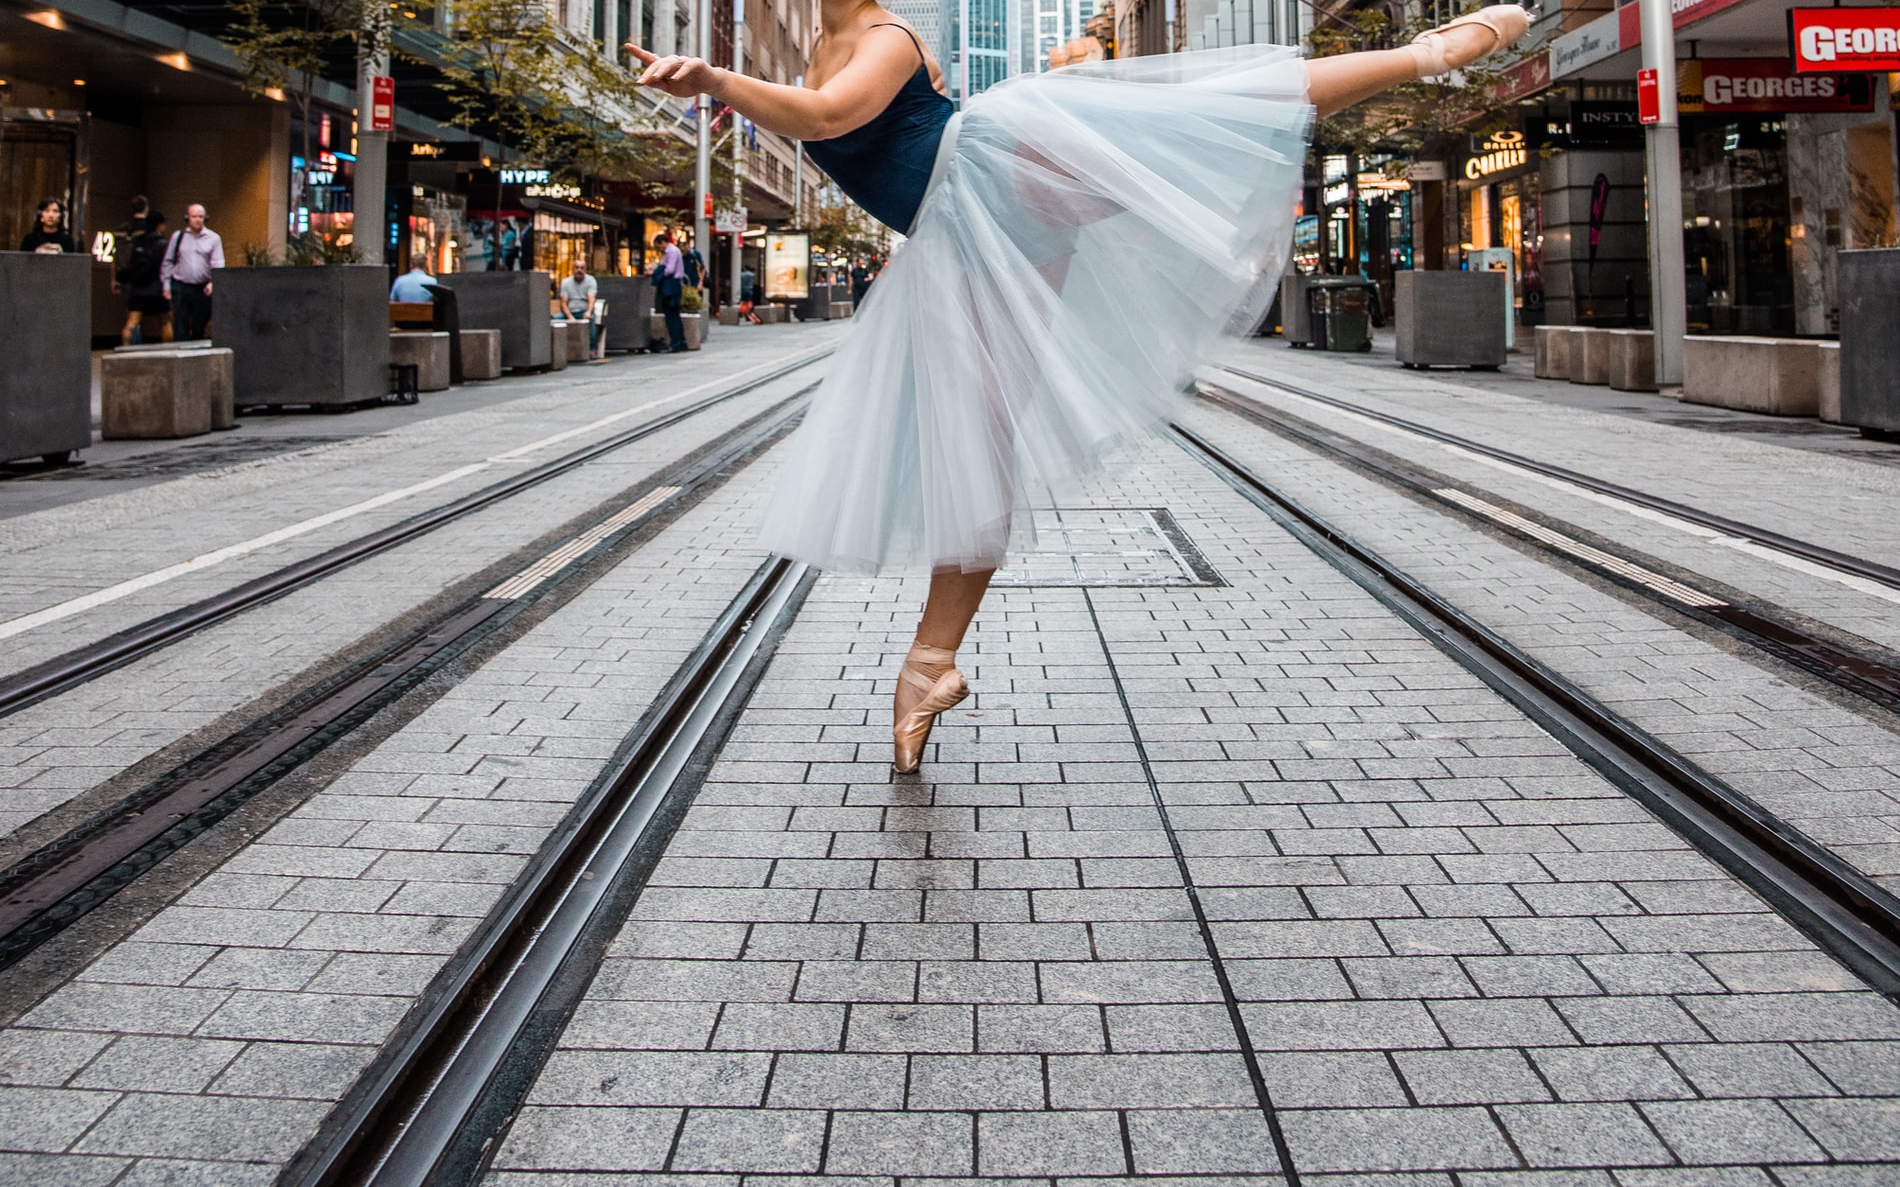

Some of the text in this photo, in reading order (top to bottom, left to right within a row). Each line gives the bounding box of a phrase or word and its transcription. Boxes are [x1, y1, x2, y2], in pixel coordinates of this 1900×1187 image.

[1800, 25, 1900, 62] GEOR
[1703, 75, 1835, 105] GEORGES
[1583, 112, 1633, 123] INSTY
[91, 231, 115, 263] 42
